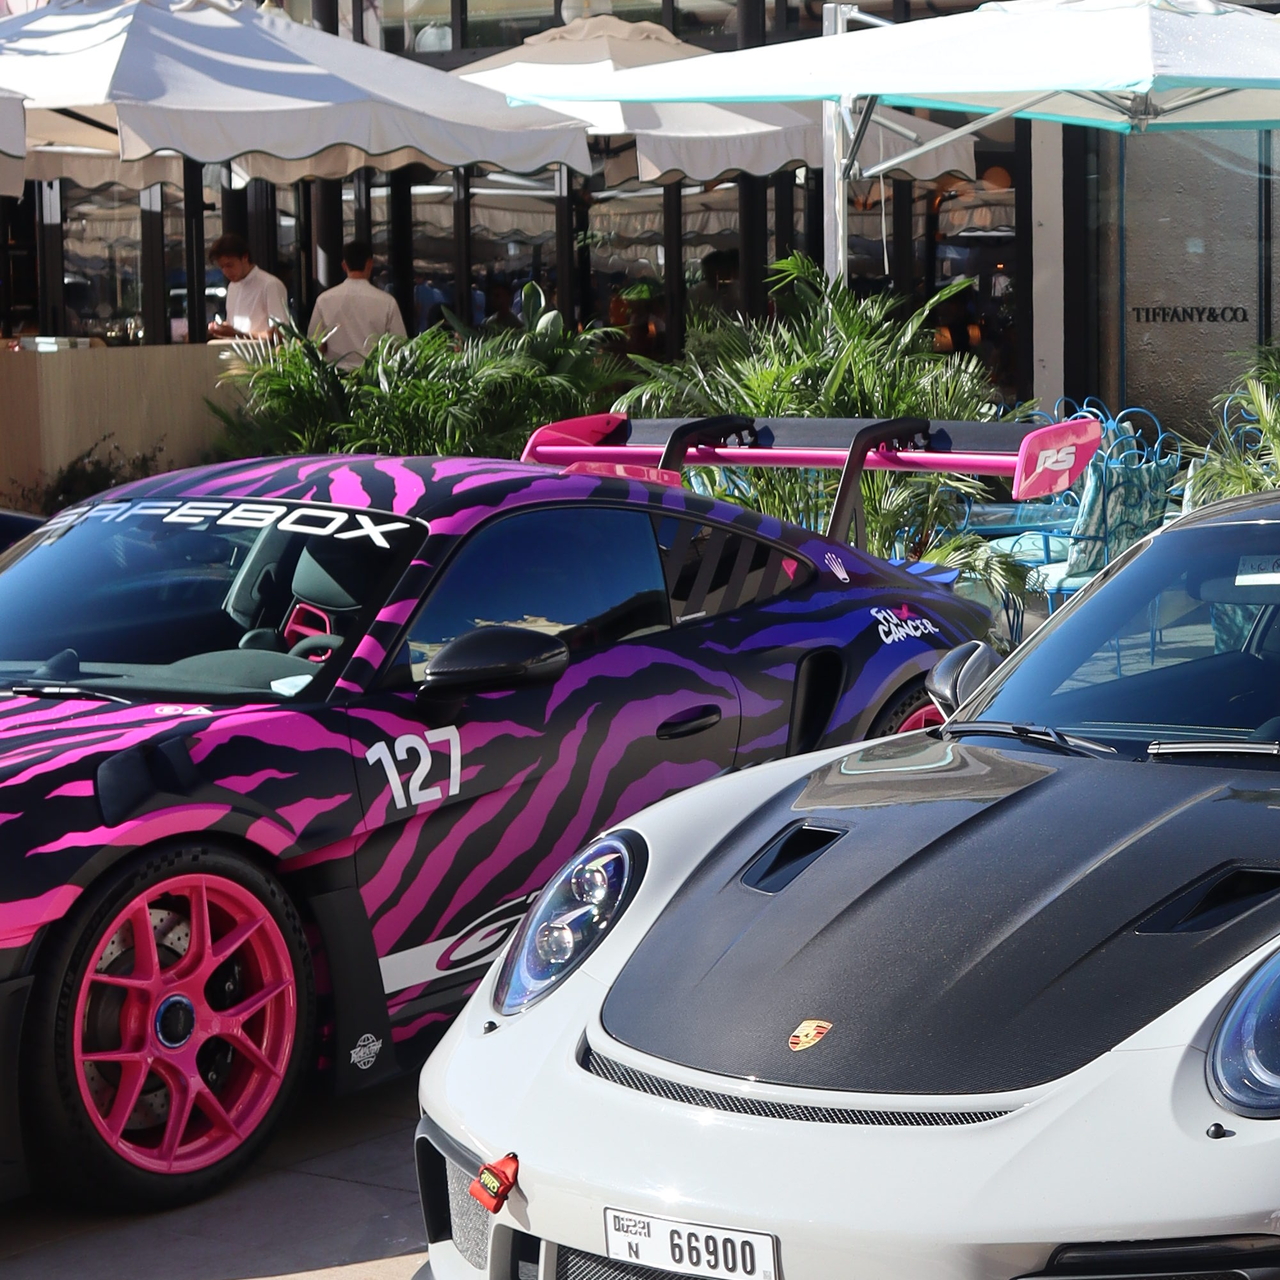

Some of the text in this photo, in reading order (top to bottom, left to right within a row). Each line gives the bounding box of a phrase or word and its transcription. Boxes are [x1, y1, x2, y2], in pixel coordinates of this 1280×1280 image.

[1036, 445, 1076, 473] RS
[33, 501, 411, 548] SAFEBOX
[878, 618, 940, 644] CANCER
[365, 724, 462, 810] 127
[627, 1241, 640, 1260] N
[670, 1229, 756, 1276] 66900
